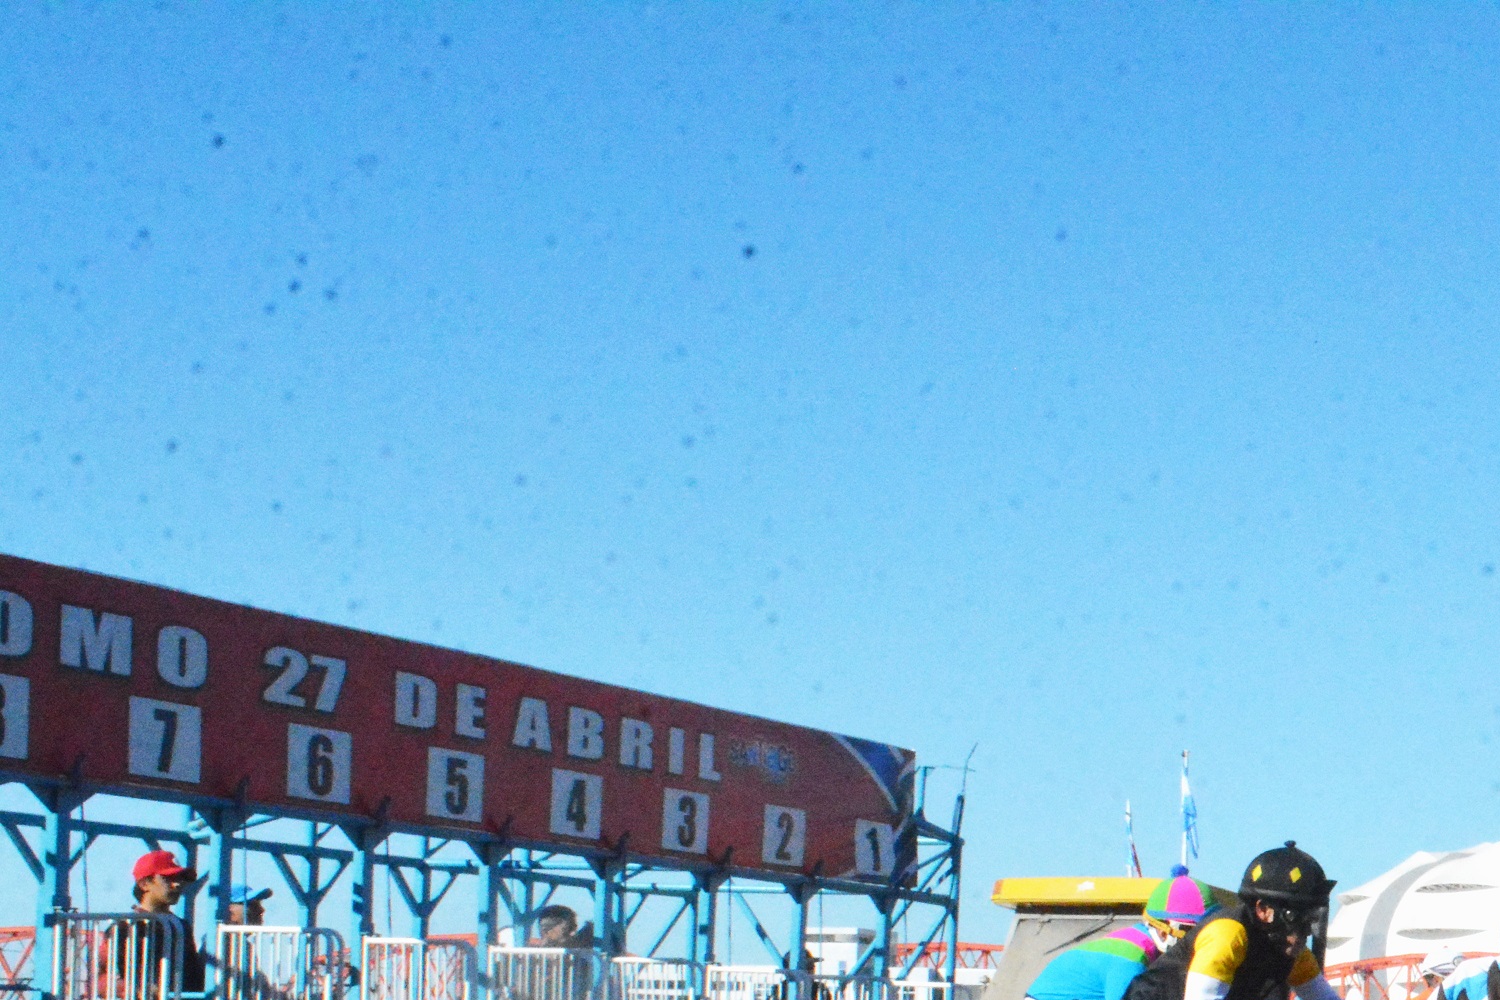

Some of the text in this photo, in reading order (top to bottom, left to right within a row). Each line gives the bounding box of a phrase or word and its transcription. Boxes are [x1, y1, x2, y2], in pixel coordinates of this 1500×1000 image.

[153, 709, 177, 773] 7
[263, 646, 347, 713] 27
[395, 671, 486, 739] DE
[512, 697, 722, 781] ABRIL
[307, 734, 335, 796] 6
[445, 758, 468, 815] 5
[566, 778, 588, 832] 4
[678, 796, 697, 848] 3
[776, 812, 793, 861] 2
[867, 827, 881, 872] 1
